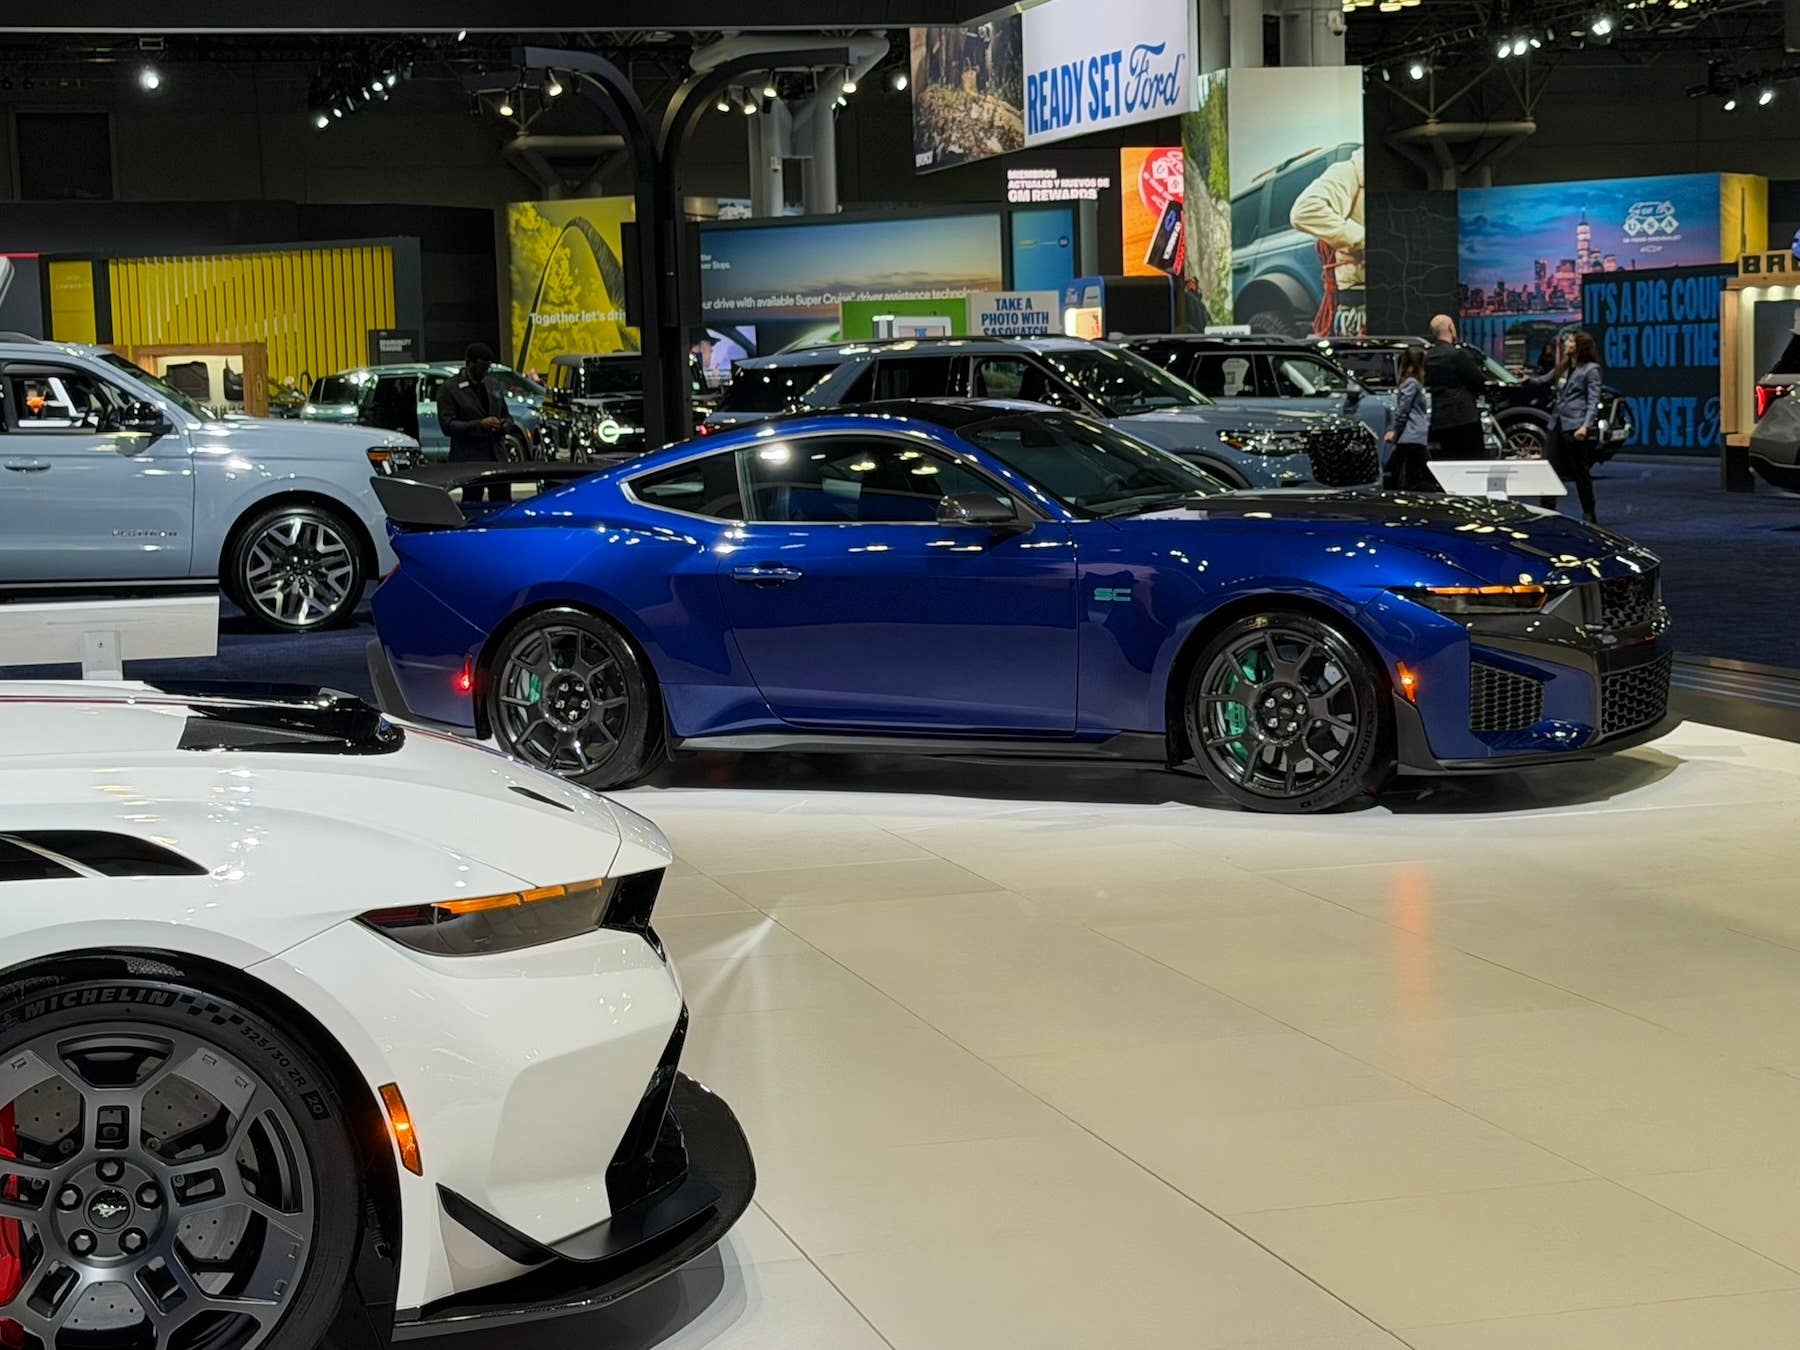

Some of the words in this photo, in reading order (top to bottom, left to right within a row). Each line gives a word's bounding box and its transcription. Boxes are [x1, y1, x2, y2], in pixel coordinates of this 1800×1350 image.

[1027, 60, 1084, 135] READY
[1088, 50, 1122, 121] SET
[1125, 42, 1182, 113] Ford
[1007, 180, 1053, 189] ACTUALES
[1008, 190, 1030, 202] GM
[1031, 189, 1097, 202] REWARDS
[711, 297, 735, 309] drive
[737, 297, 755, 308] with
[796, 294, 822, 308] Super
[994, 298, 1022, 311] TAKE
[1025, 298, 1033, 311] A
[1585, 283, 1618, 324] IT'S
[1620, 282, 1633, 323] A
[1636, 279, 1668, 322] BIG
[530, 311, 579, 326] Together
[981, 313, 1019, 326] PHOTO
[1021, 312, 1049, 325] WITH
[983, 325, 1048, 336] SASQUATCH
[1604, 326, 1639, 368] GET
[1642, 324, 1678, 367] OUT
[1682, 323, 1720, 366] THE
[1656, 396, 1697, 447] SET
[25, 988, 169, 1020] MICHELIN
[240, 1026, 290, 1068] 325/30
